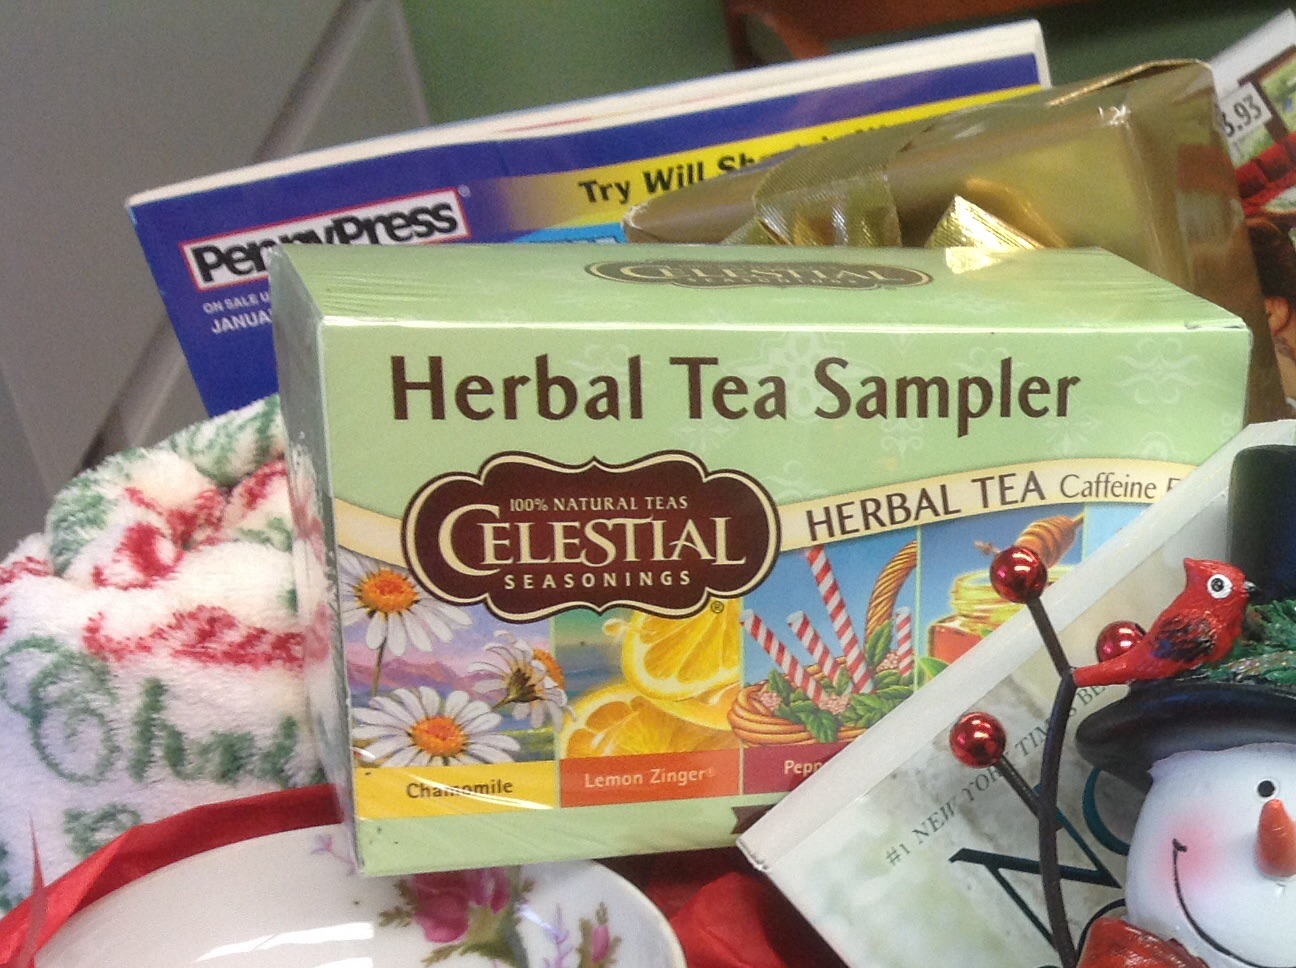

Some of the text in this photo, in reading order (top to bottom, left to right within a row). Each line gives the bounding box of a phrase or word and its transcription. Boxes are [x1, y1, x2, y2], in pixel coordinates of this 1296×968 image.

[577, 178, 631, 205] Try
[642, 160, 705, 194] Will
[190, 202, 458, 282] PenPress
[203, 291, 270, 314] ON SALE U
[211, 310, 272, 334] JANUA
[390, 353, 1081, 438] Herbal Tea Sampler
[509, 496, 688, 513] 100% NATURAL TEAS
[805, 484, 961, 541] HERBAL
[971, 470, 1046, 509] TEA
[1059, 471, 1157, 500] Caffeine
[437, 503, 747, 576] CELESTIAL
[505, 570, 691, 590] SEASONINGS
[406, 777, 513, 799] Chamomile
[584, 771, 643, 789] Lemon
[885, 843, 910, 867] #1
[911, 798, 956, 846] NEW
[1015, 703, 1077, 759] TIMS
